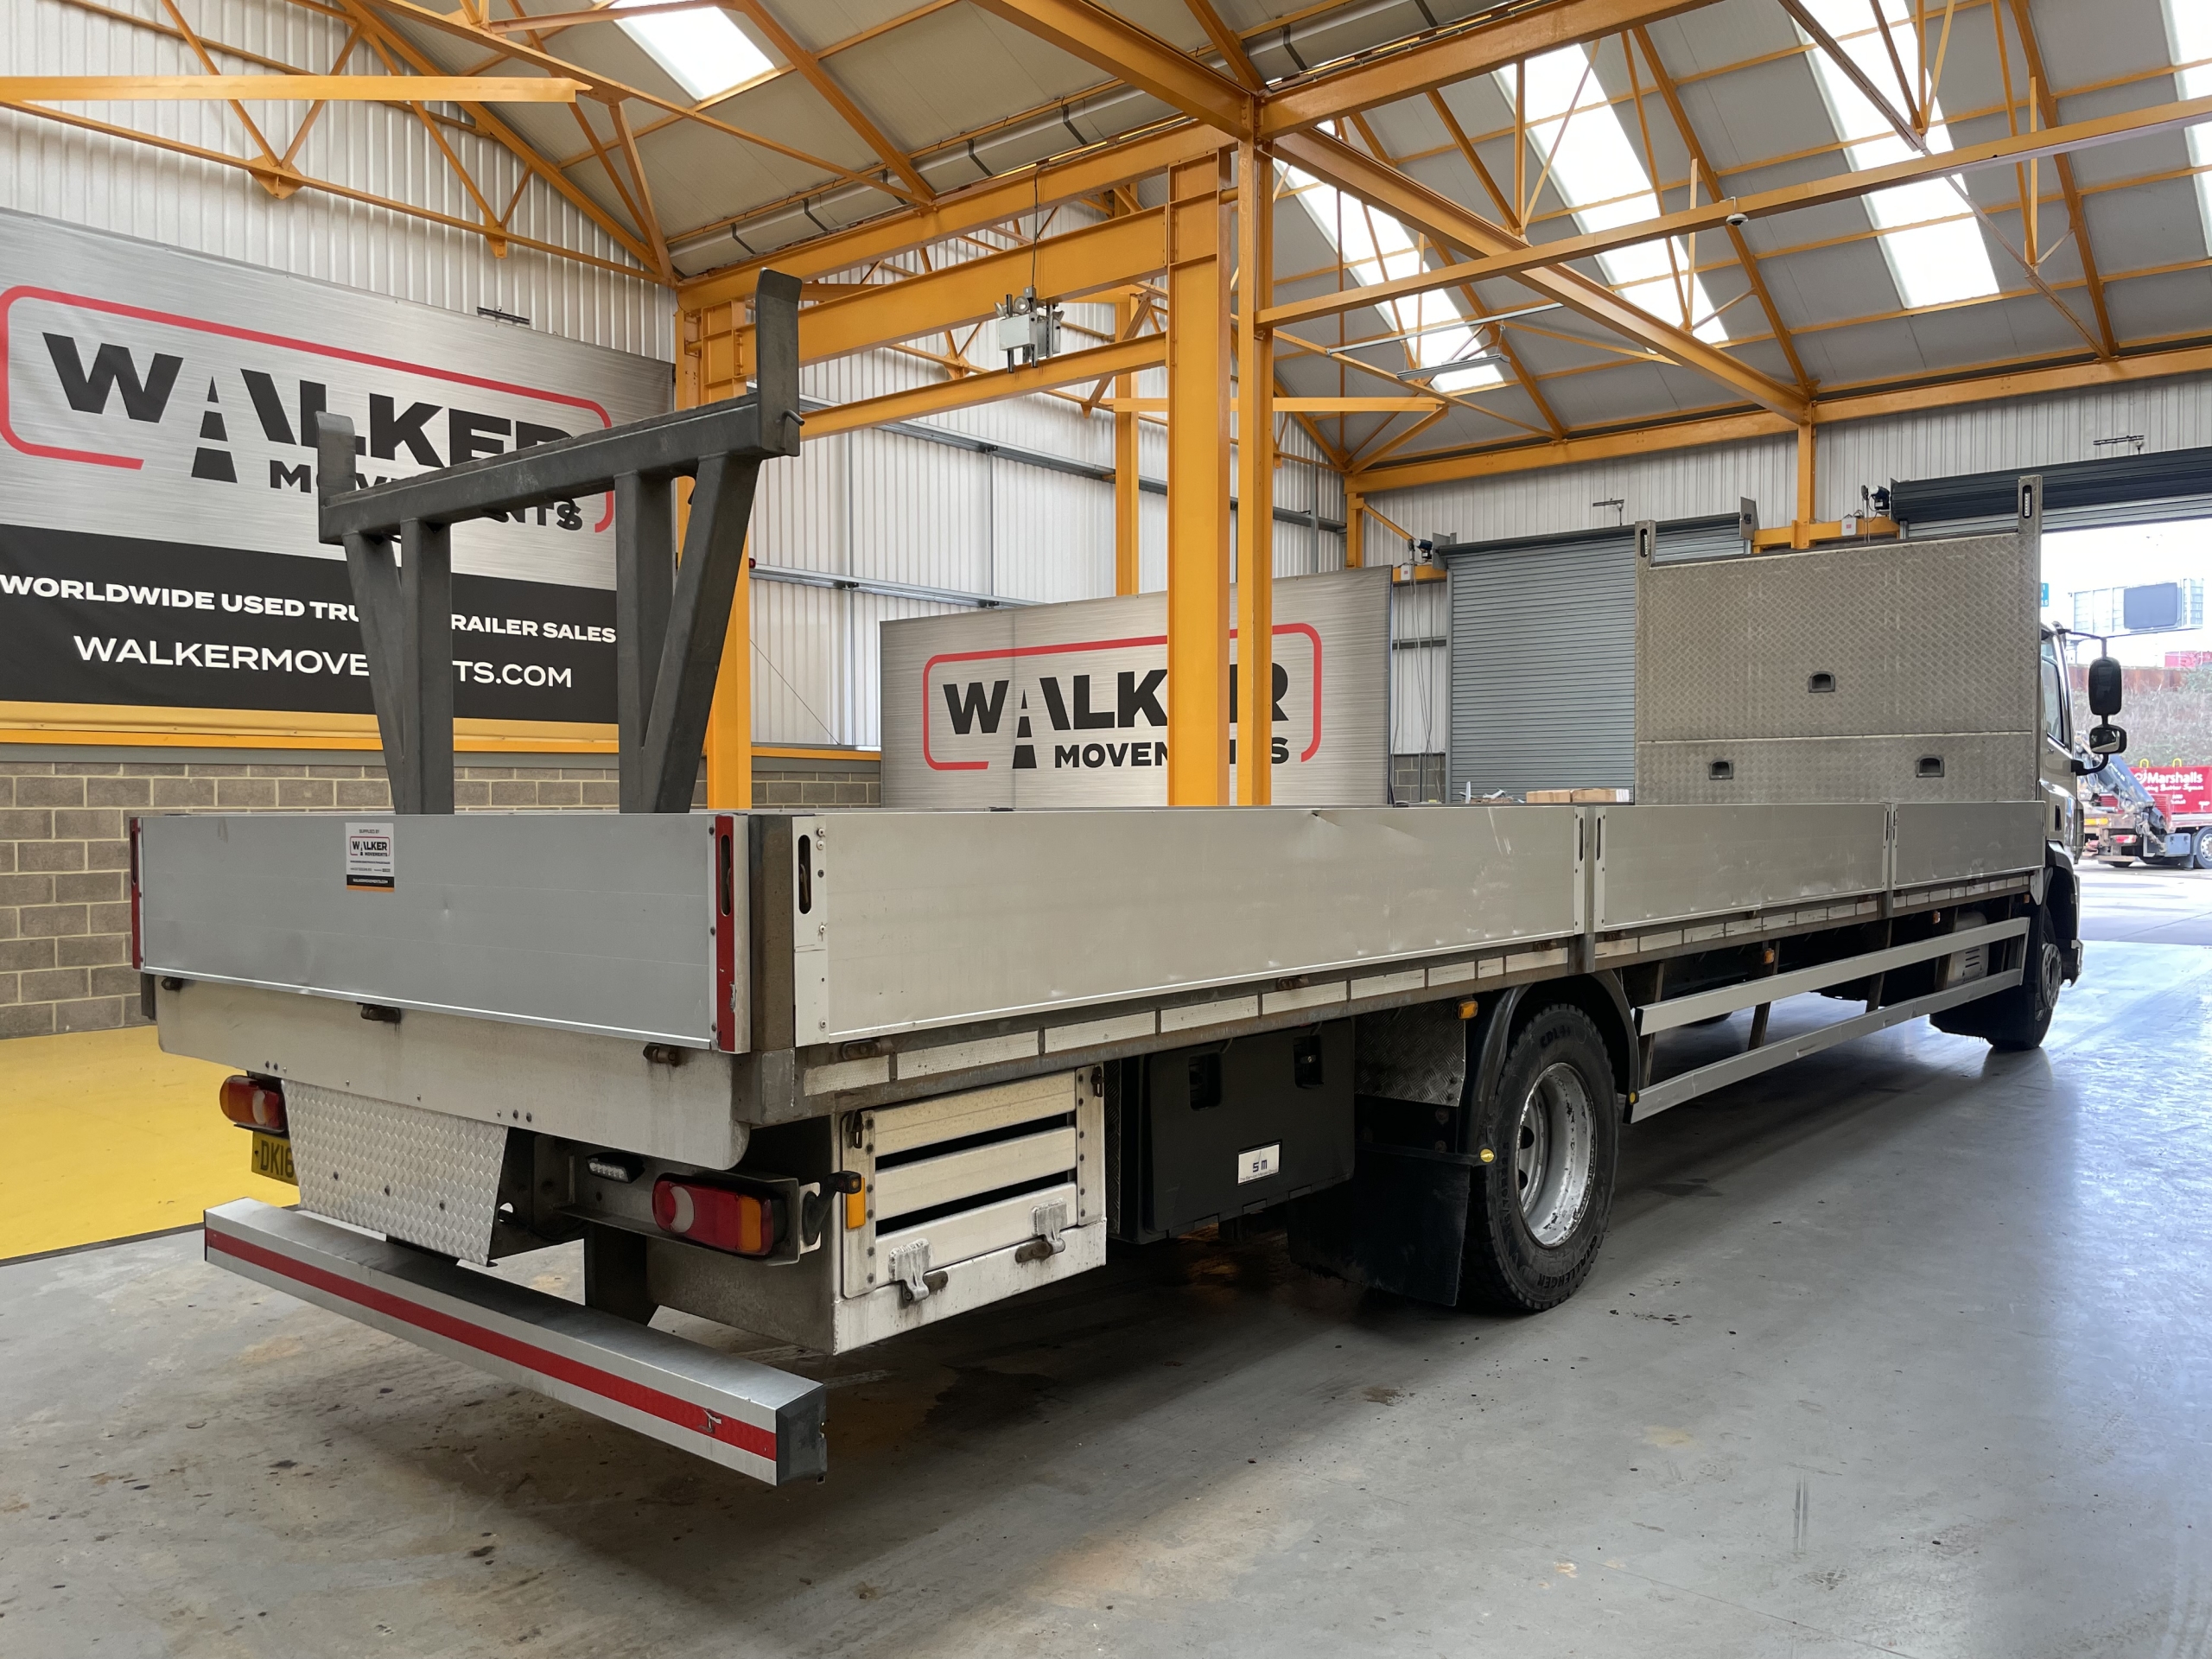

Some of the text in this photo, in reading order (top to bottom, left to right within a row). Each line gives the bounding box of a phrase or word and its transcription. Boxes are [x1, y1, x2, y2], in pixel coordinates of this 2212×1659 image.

[42, 332, 574, 484] WALKE
[0, 575, 617, 643] WORLDWIDE USED TRU RAILER SALES
[73, 635, 572, 688] WALKERMOVETS.COM
[943, 662, 1289, 769] WALKR
[1054, 736, 1289, 768] MOVES
[2147, 771, 2203, 784] Marshalls
[352, 841, 388, 855] WALKER
